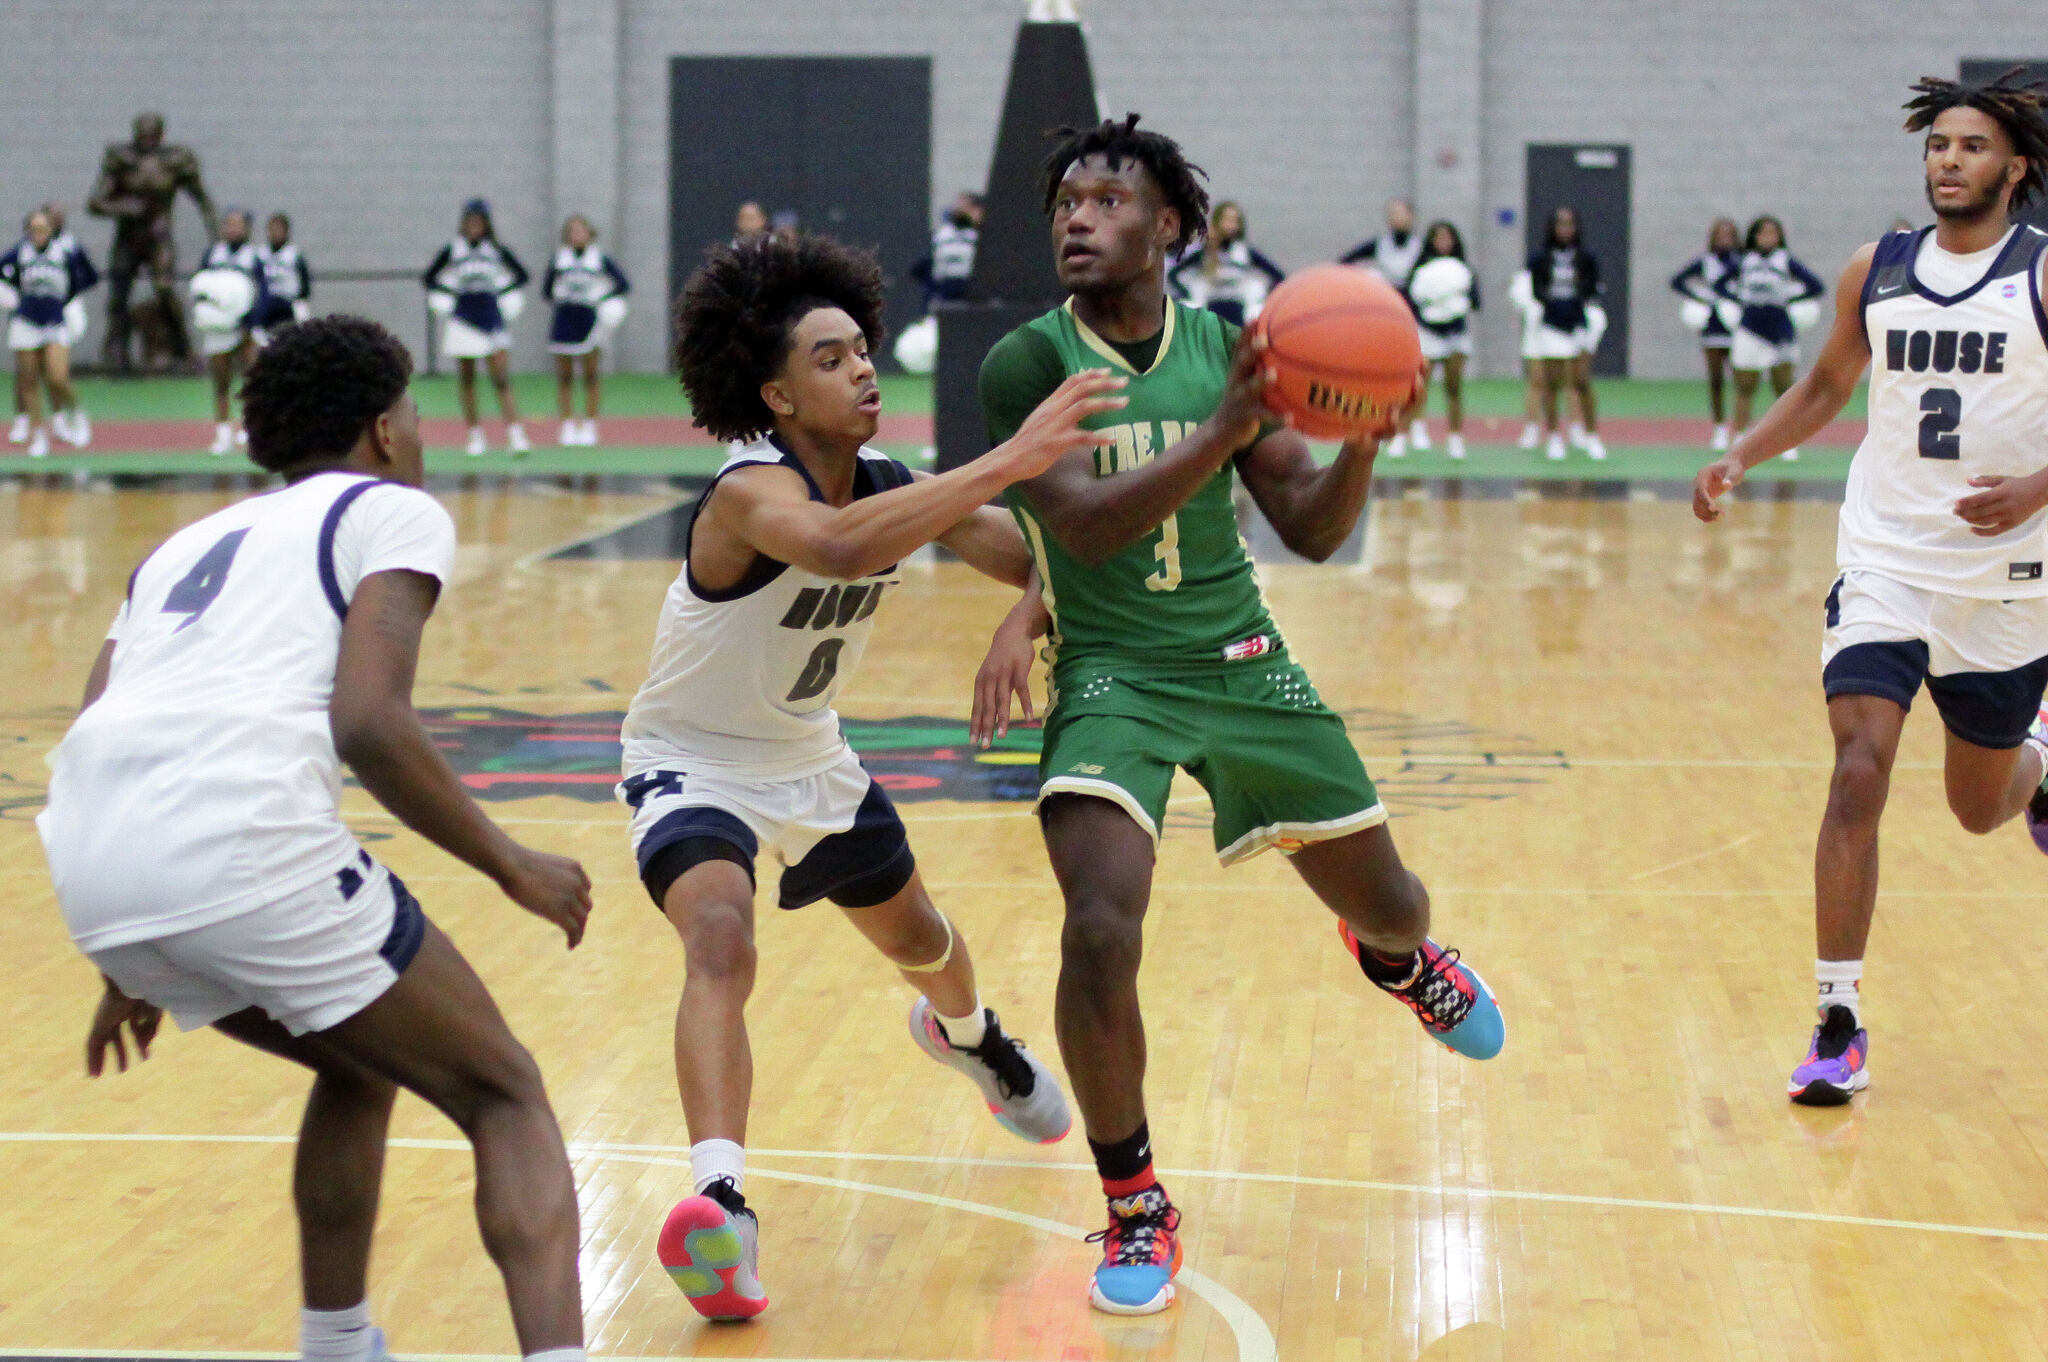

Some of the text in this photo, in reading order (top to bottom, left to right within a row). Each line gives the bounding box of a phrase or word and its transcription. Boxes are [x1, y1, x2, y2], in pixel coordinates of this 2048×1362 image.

[1886, 329, 2007, 373] HOUSE
[1918, 388, 1961, 459] 2
[160, 526, 252, 635] 4
[1144, 511, 1182, 592] 3
[786, 638, 845, 701] 0
